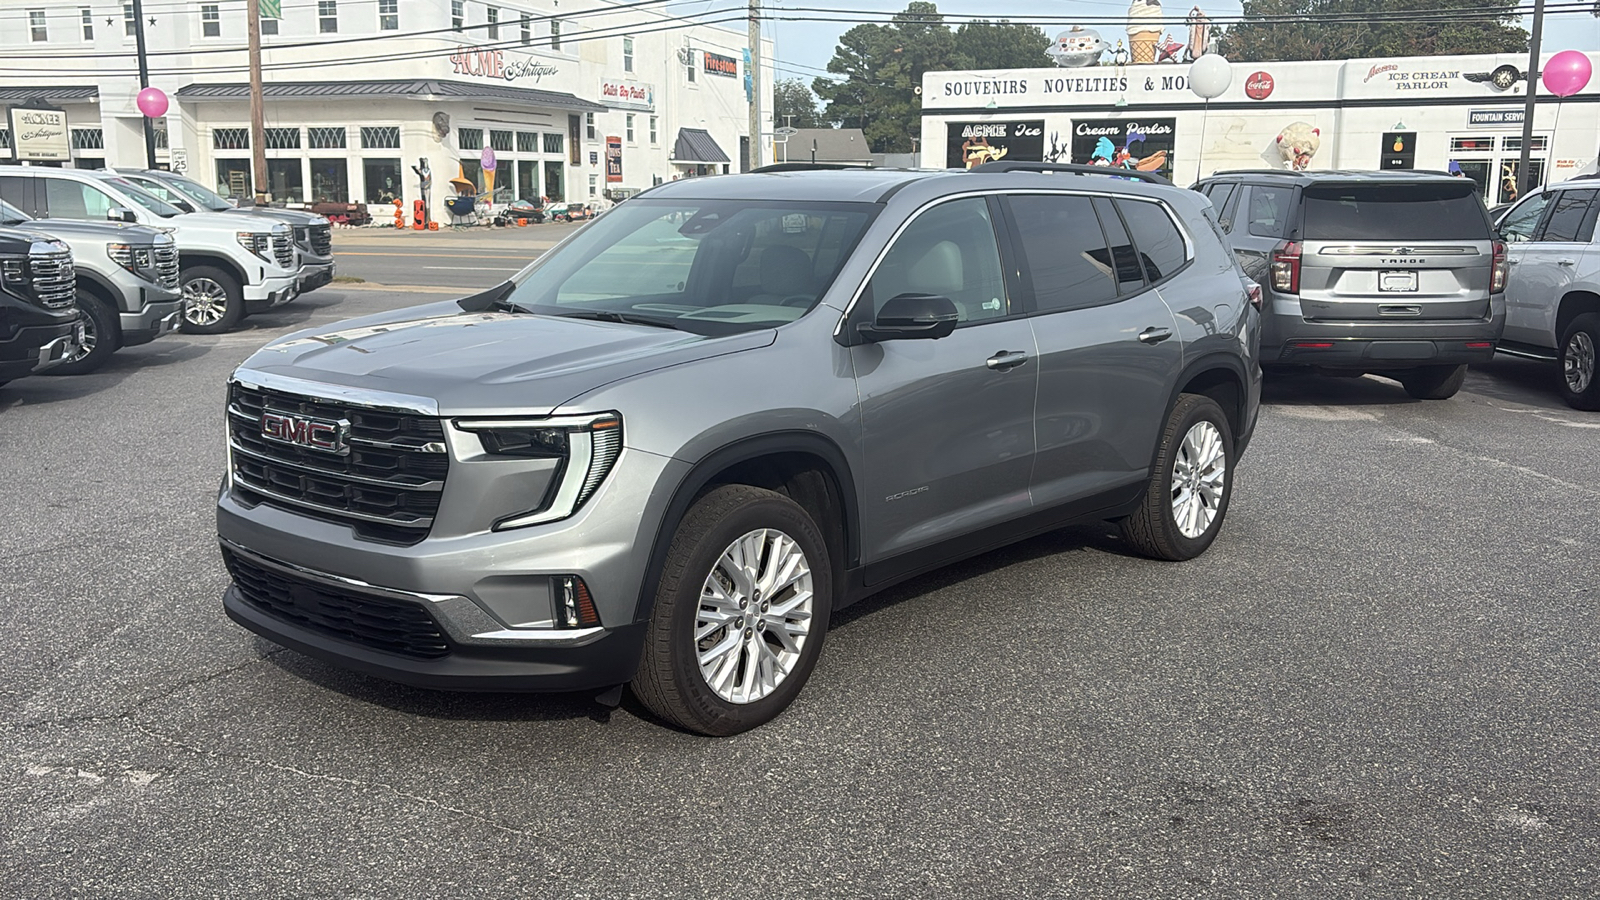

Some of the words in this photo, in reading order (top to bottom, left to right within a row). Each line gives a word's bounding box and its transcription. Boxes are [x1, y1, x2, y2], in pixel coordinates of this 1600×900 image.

[450, 44, 504, 79] ACME
[504, 55, 559, 83] Antiques
[704, 52, 736, 74] Firestone
[1388, 72, 1409, 81] ICE
[1412, 71, 1460, 80] CREAM
[603, 83, 618, 96] Dutch
[619, 85, 629, 100] Boy
[630, 86, 646, 99] Paints
[944, 80, 1027, 96] SOUVENIRS
[1043, 77, 1128, 93] NOVELTIES
[1144, 76, 1155, 91] &
[1396, 81, 1448, 90] PARLOR
[21, 112, 61, 126] ACME
[1472, 112, 1503, 122] FOUNTAIN
[961, 124, 1007, 138] ACME
[1014, 123, 1042, 137] Ice
[1075, 122, 1121, 136] Cream
[1125, 121, 1173, 135] Parlor
[174, 160, 187, 170] 25
[261, 412, 337, 451] GMC
[885, 485, 929, 502] ACADIA
